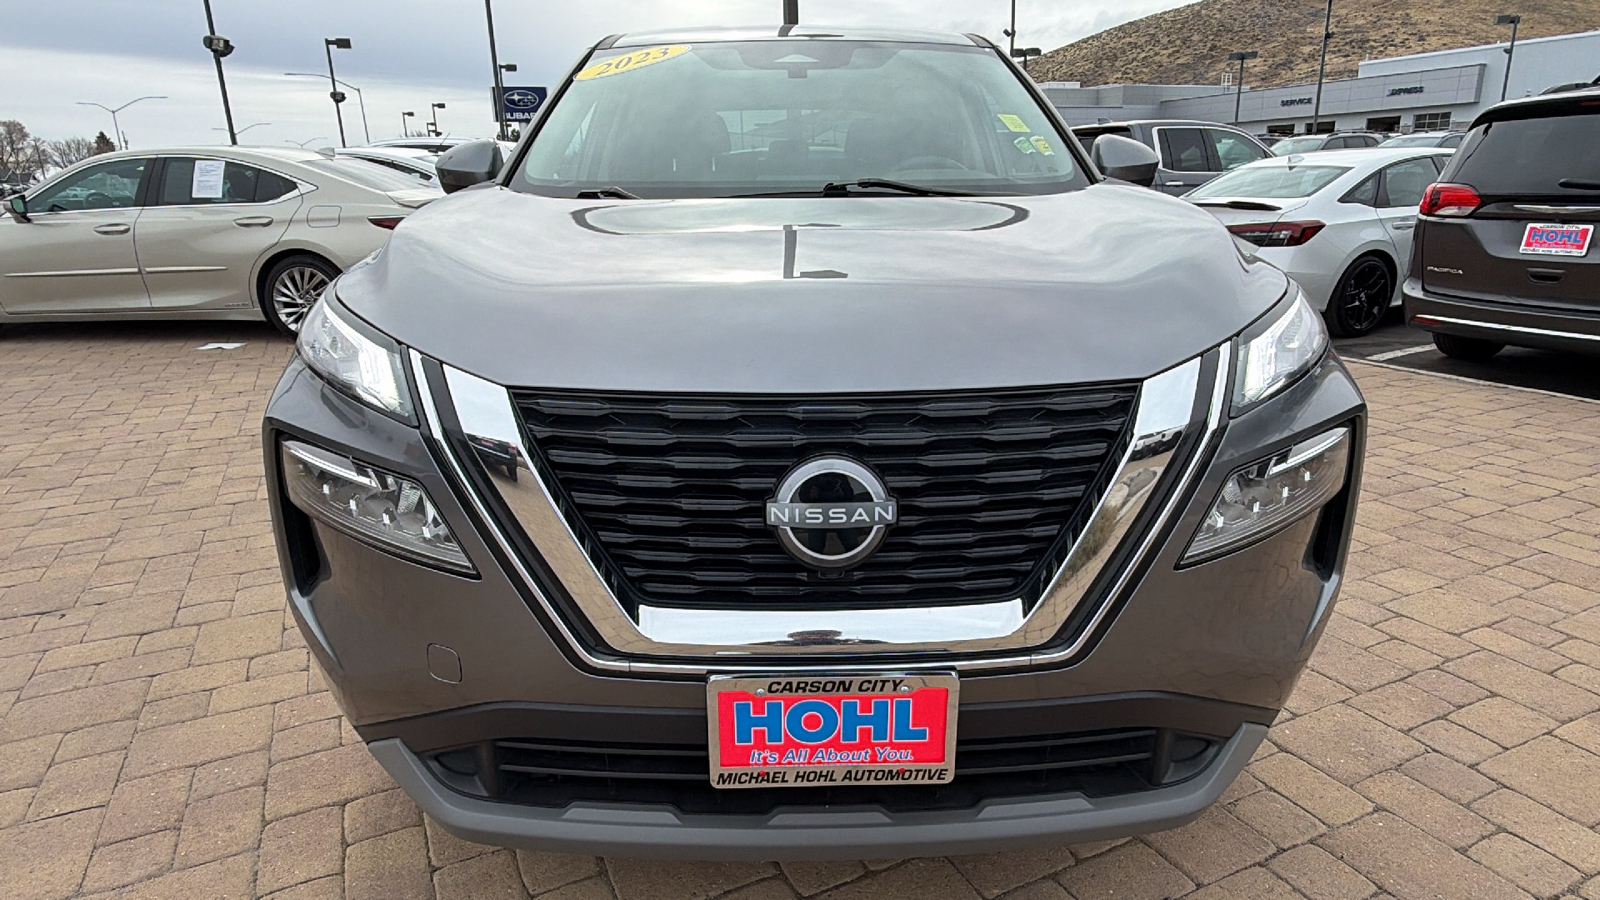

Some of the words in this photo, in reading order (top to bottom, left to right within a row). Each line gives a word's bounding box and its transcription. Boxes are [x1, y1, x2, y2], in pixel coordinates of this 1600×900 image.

[594, 47, 671, 77] 2023
[1280, 97, 1313, 107] SERVICE
[1530, 229, 1582, 244] HOHL
[770, 505, 893, 524] NISSAN
[767, 680, 853, 694] CARSON
[857, 679, 905, 692] CITY
[733, 697, 929, 746] HOHL
[750, 749, 778, 764] It's
[783, 748, 810, 763] All
[812, 747, 870, 763] About
[875, 746, 914, 761] You.
[716, 770, 789, 785] MICHAEL
[794, 769, 838, 783] HOHL
[841, 768, 949, 782] AUTOMOTIVE
